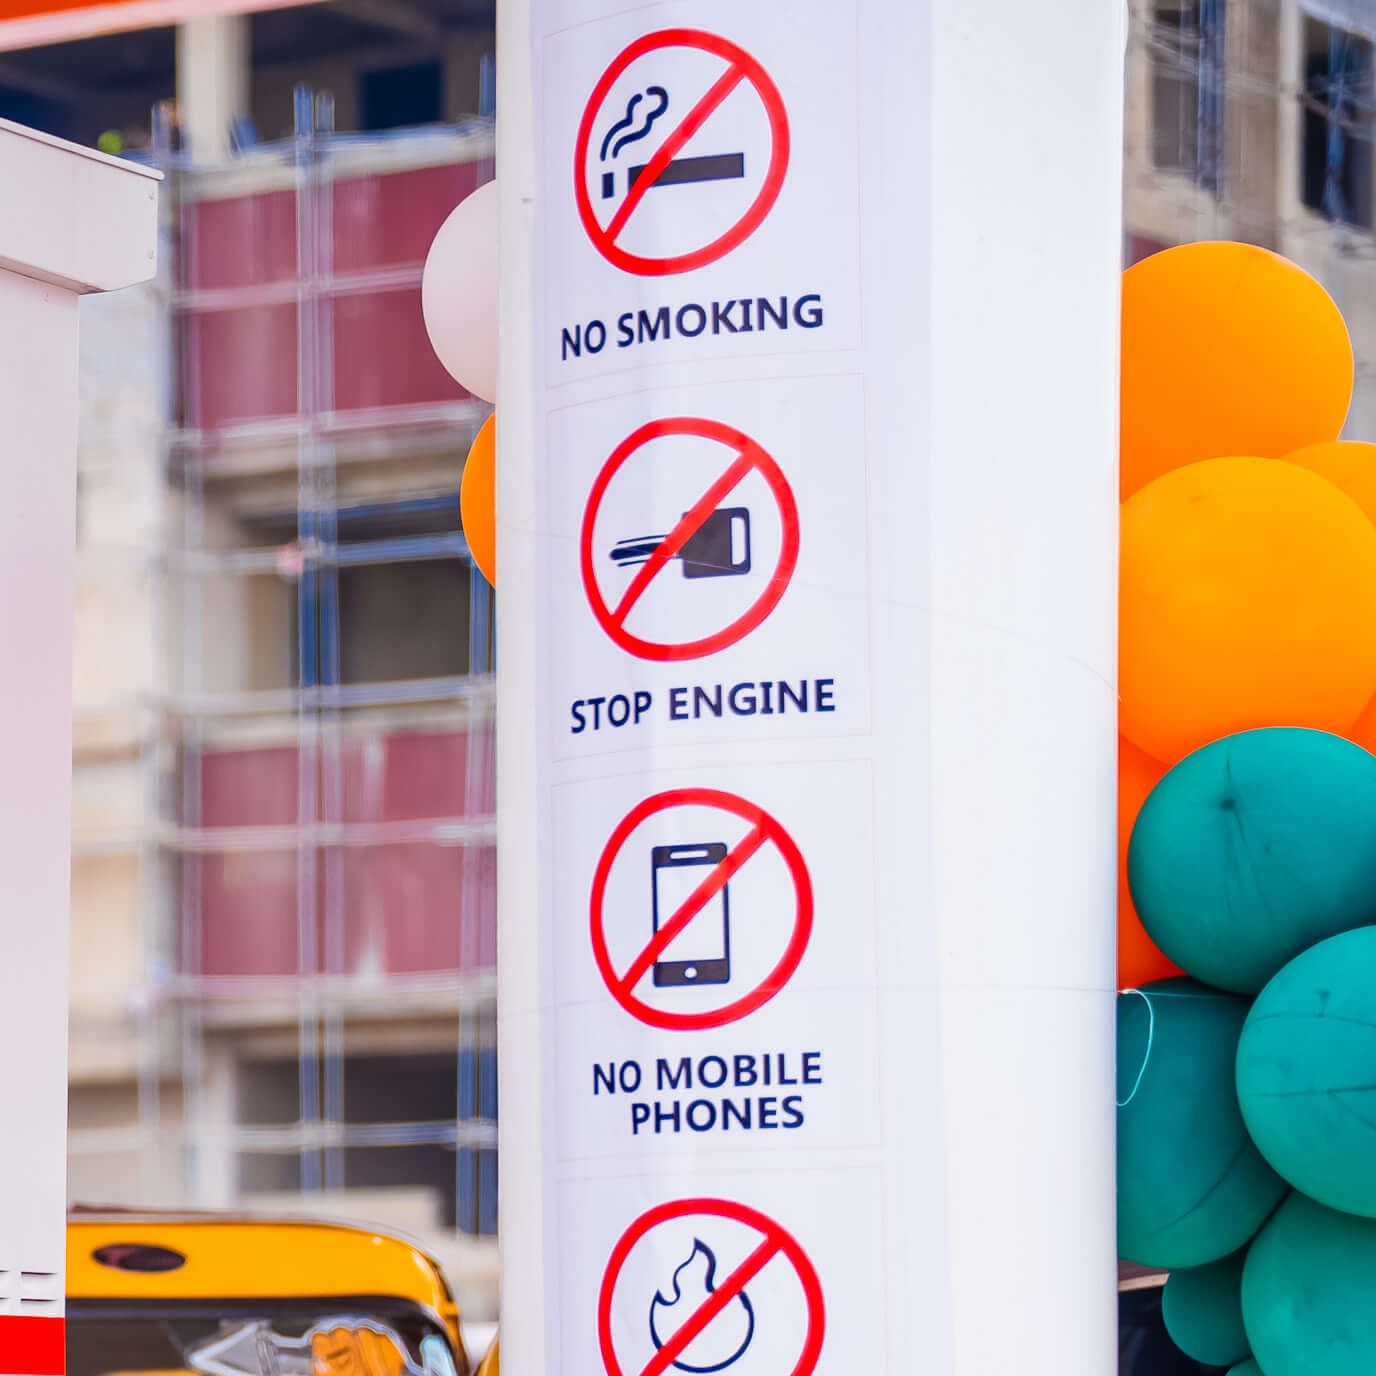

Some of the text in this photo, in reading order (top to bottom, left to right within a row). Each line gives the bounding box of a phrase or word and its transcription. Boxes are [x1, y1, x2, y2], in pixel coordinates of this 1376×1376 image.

[562, 294, 823, 360] NO SMOKING
[571, 679, 835, 734] STOP ENGINE
[593, 1052, 822, 1095] NO MOBILE
[631, 1095, 804, 1135] PHONES
